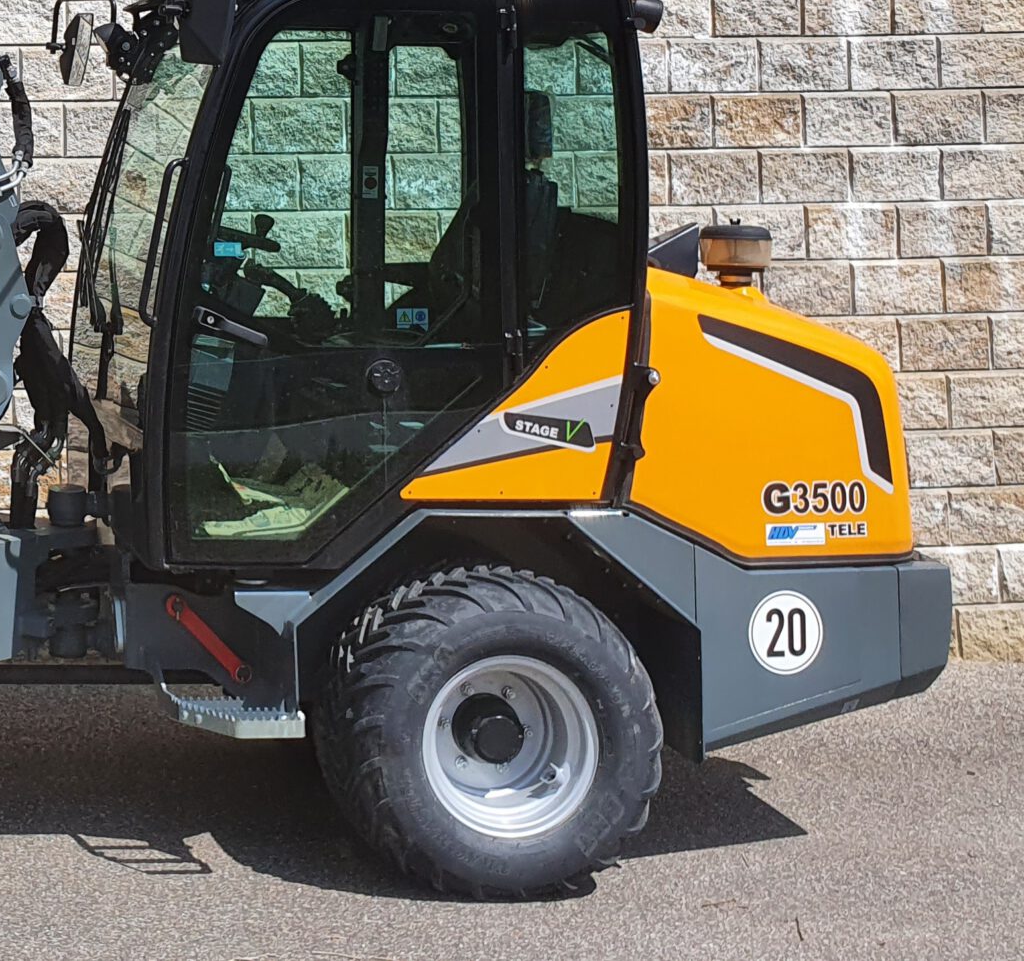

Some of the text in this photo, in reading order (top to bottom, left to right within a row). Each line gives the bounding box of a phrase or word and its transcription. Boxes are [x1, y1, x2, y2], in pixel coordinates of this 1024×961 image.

[514, 419, 559, 439] STAGE
[761, 480, 867, 516] G3500
[827, 523, 866, 537] TELE
[765, 607, 807, 658] 20
